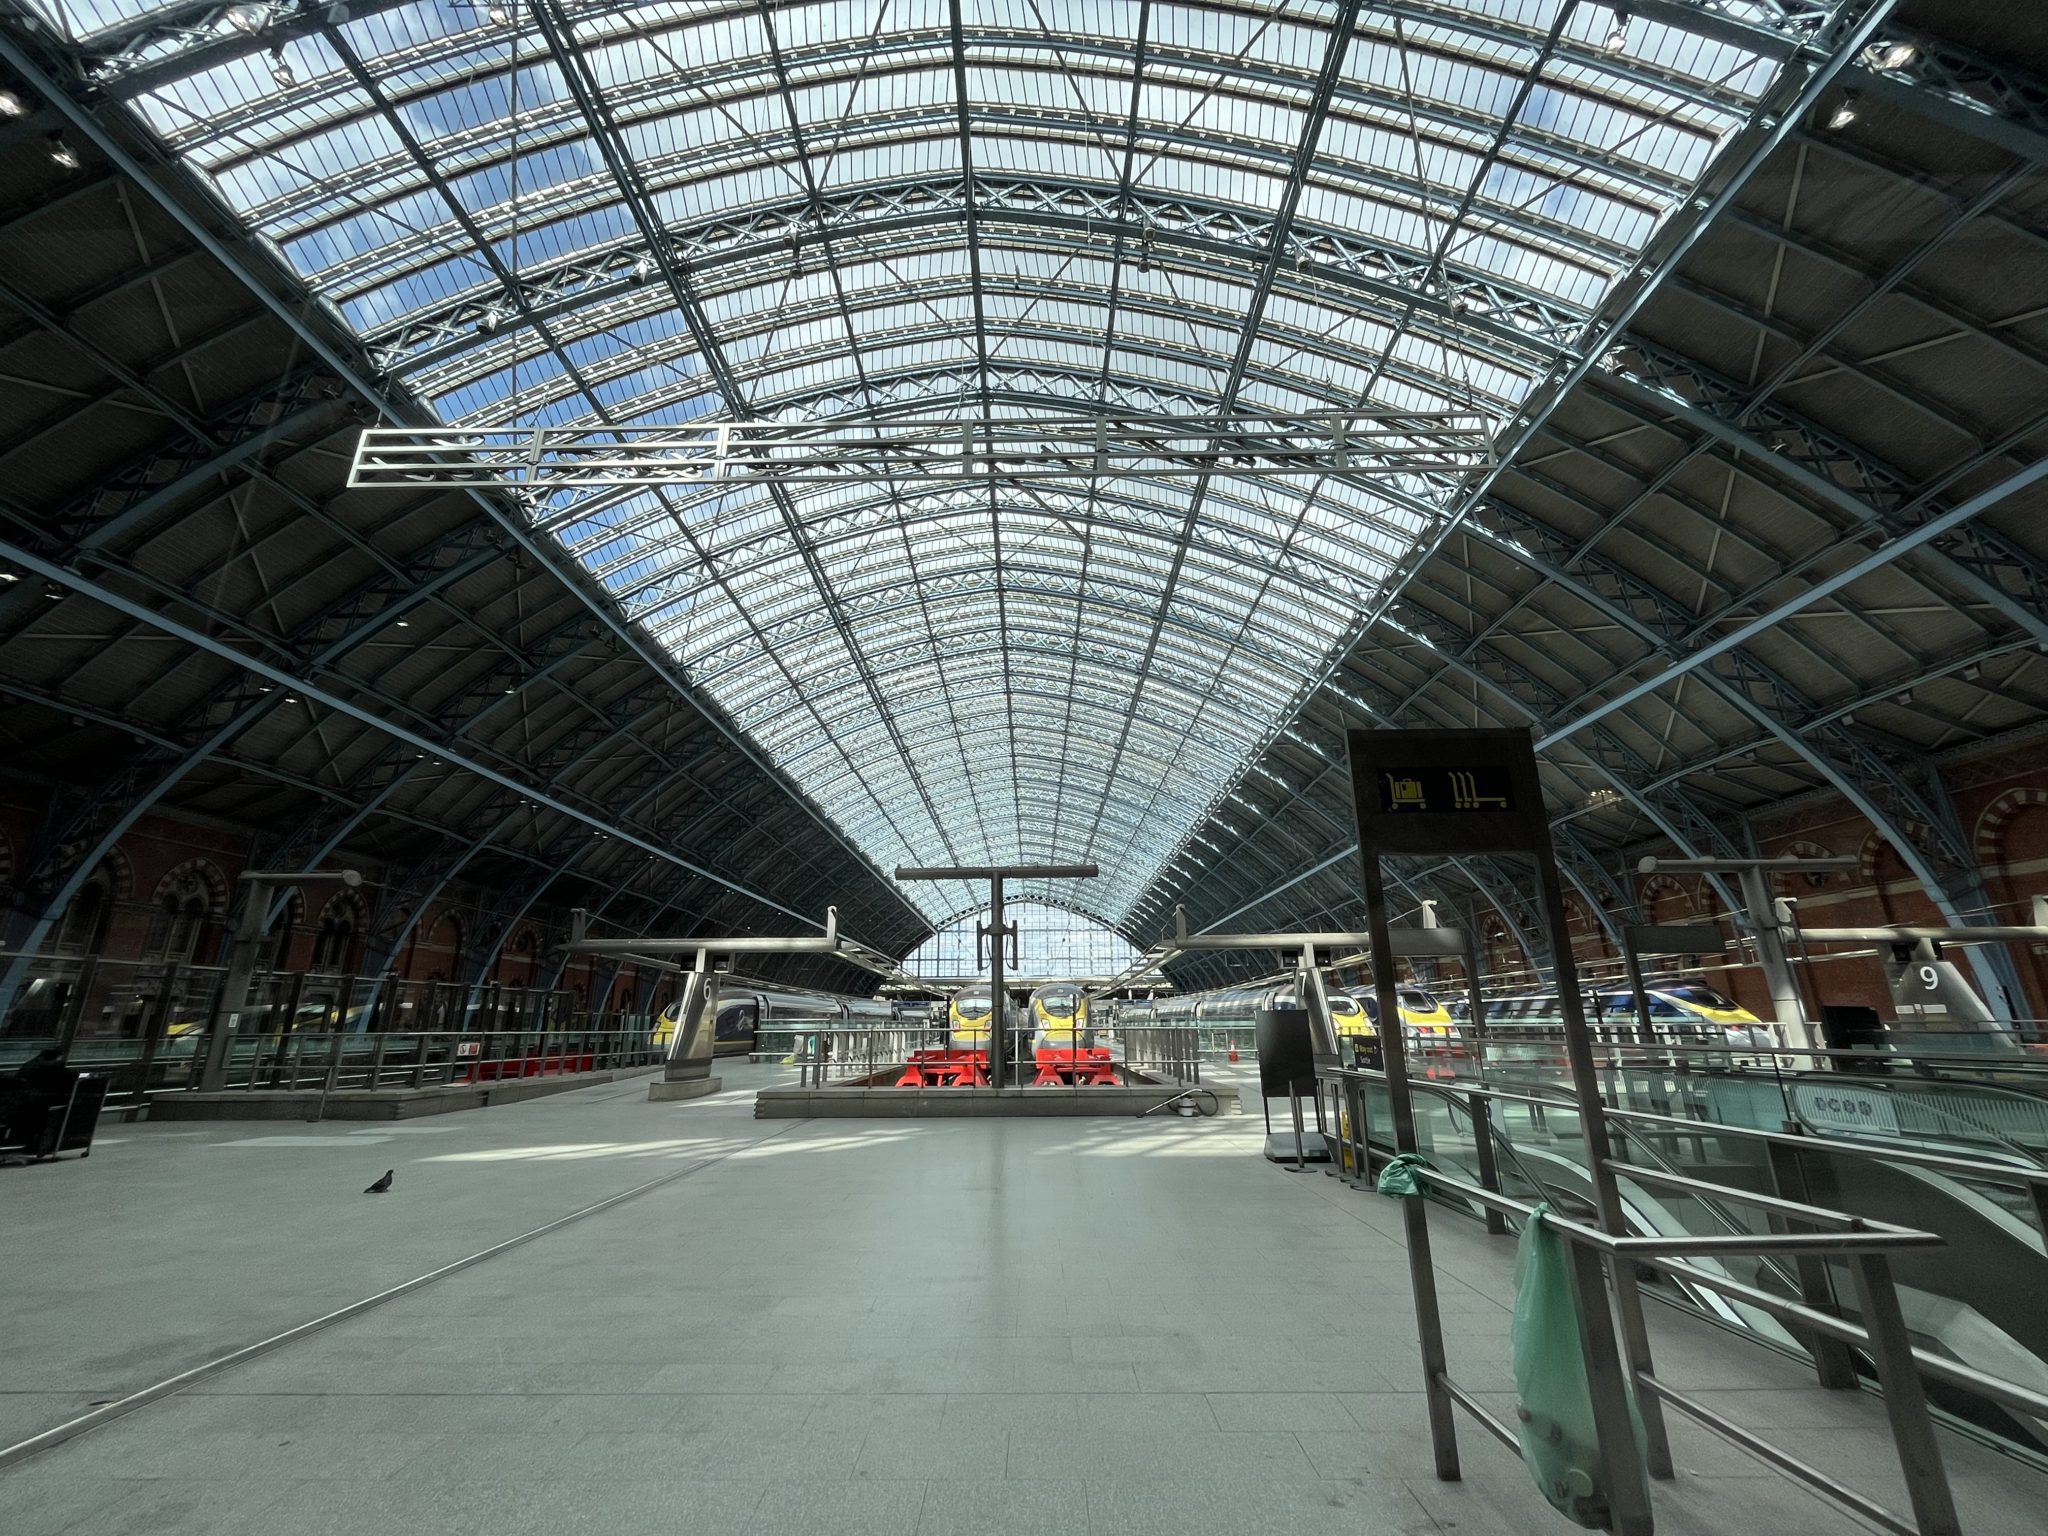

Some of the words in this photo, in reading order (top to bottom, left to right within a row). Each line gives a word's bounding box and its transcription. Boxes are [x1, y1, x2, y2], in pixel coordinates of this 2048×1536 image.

[703, 977, 712, 1001] 6
[1299, 971, 1307, 996] 7
[1920, 966, 1939, 990] 9
